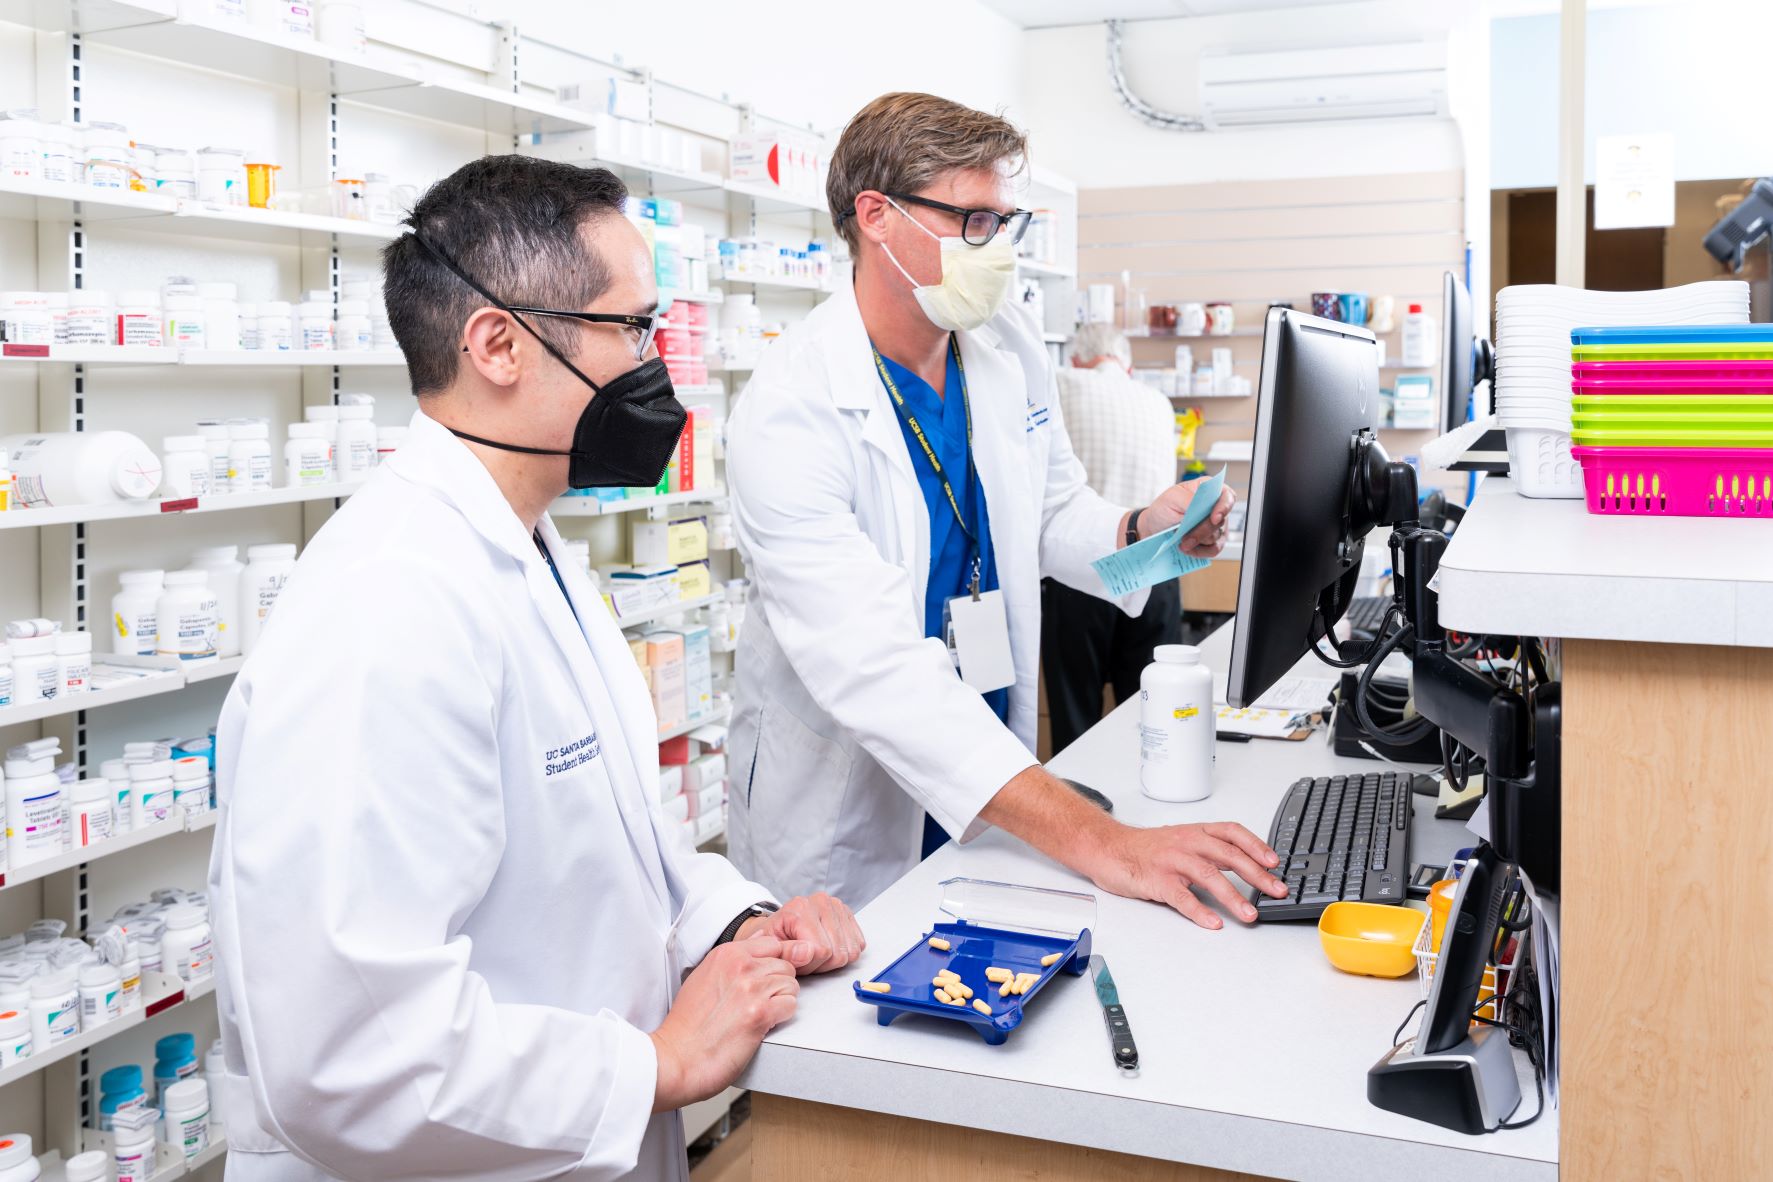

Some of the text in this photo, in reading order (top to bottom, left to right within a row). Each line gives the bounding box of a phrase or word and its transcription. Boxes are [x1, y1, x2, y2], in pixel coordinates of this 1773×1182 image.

[908, 416, 941, 472] UCSB Student Health
[546, 749, 559, 761] UC
[560, 742, 580, 757] SANTA
[545, 758, 578, 776] Student
